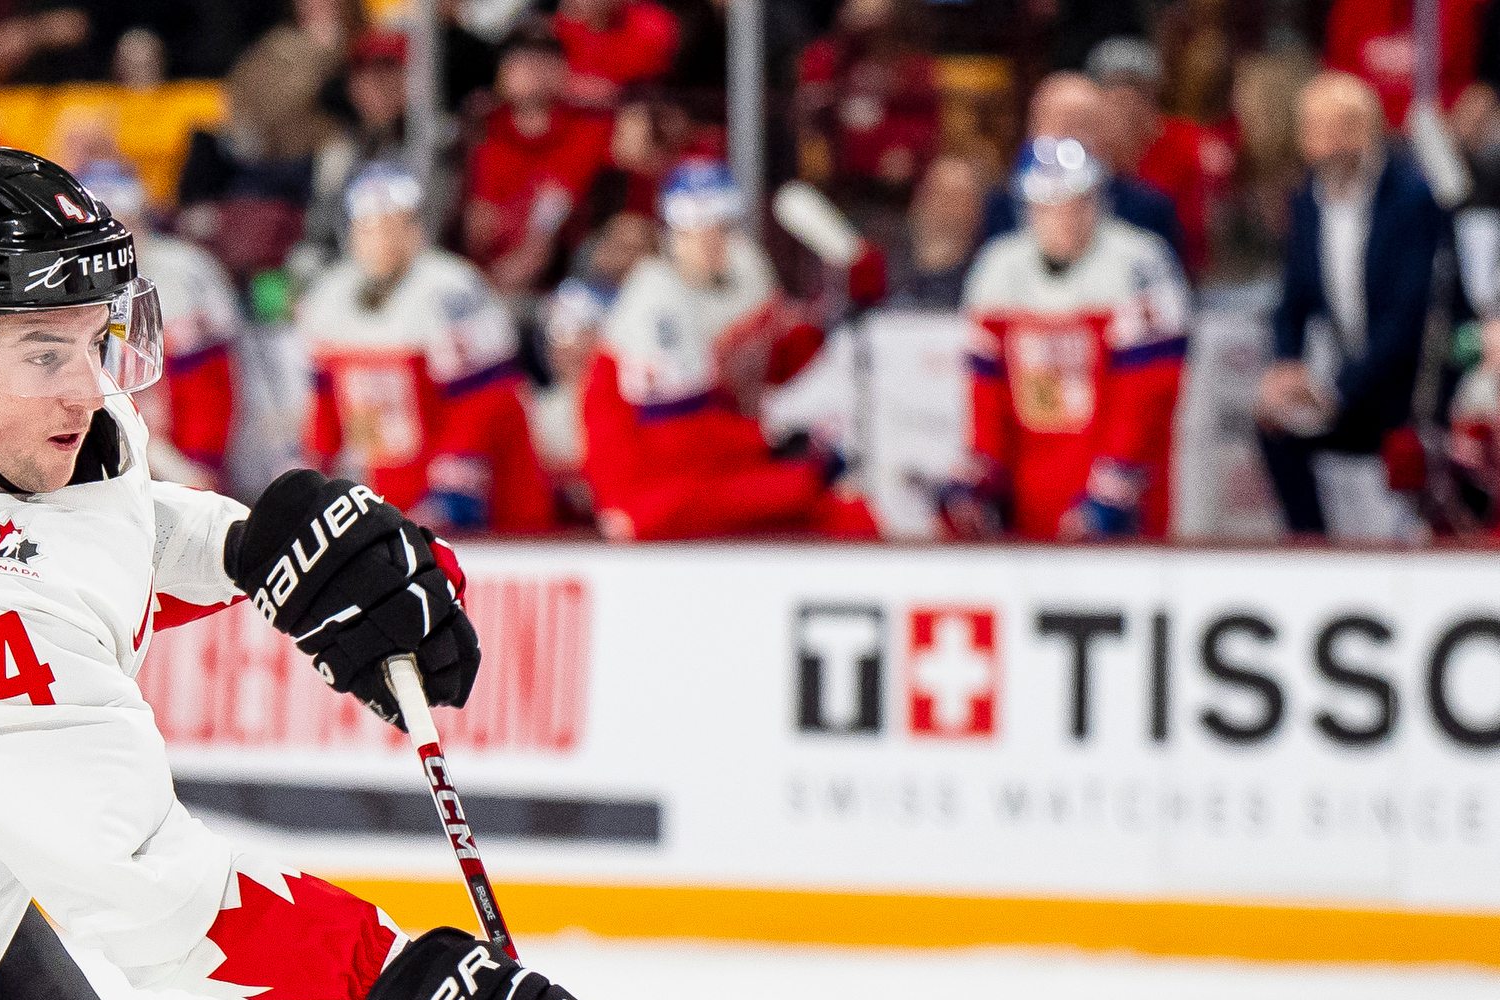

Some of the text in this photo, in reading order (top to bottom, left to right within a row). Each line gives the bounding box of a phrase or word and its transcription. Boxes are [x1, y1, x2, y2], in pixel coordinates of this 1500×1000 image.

[54, 193, 88, 223] 4
[78, 244, 135, 277] TELUS
[252, 484, 385, 628] BAUER
[424, 755, 480, 860] CCM
